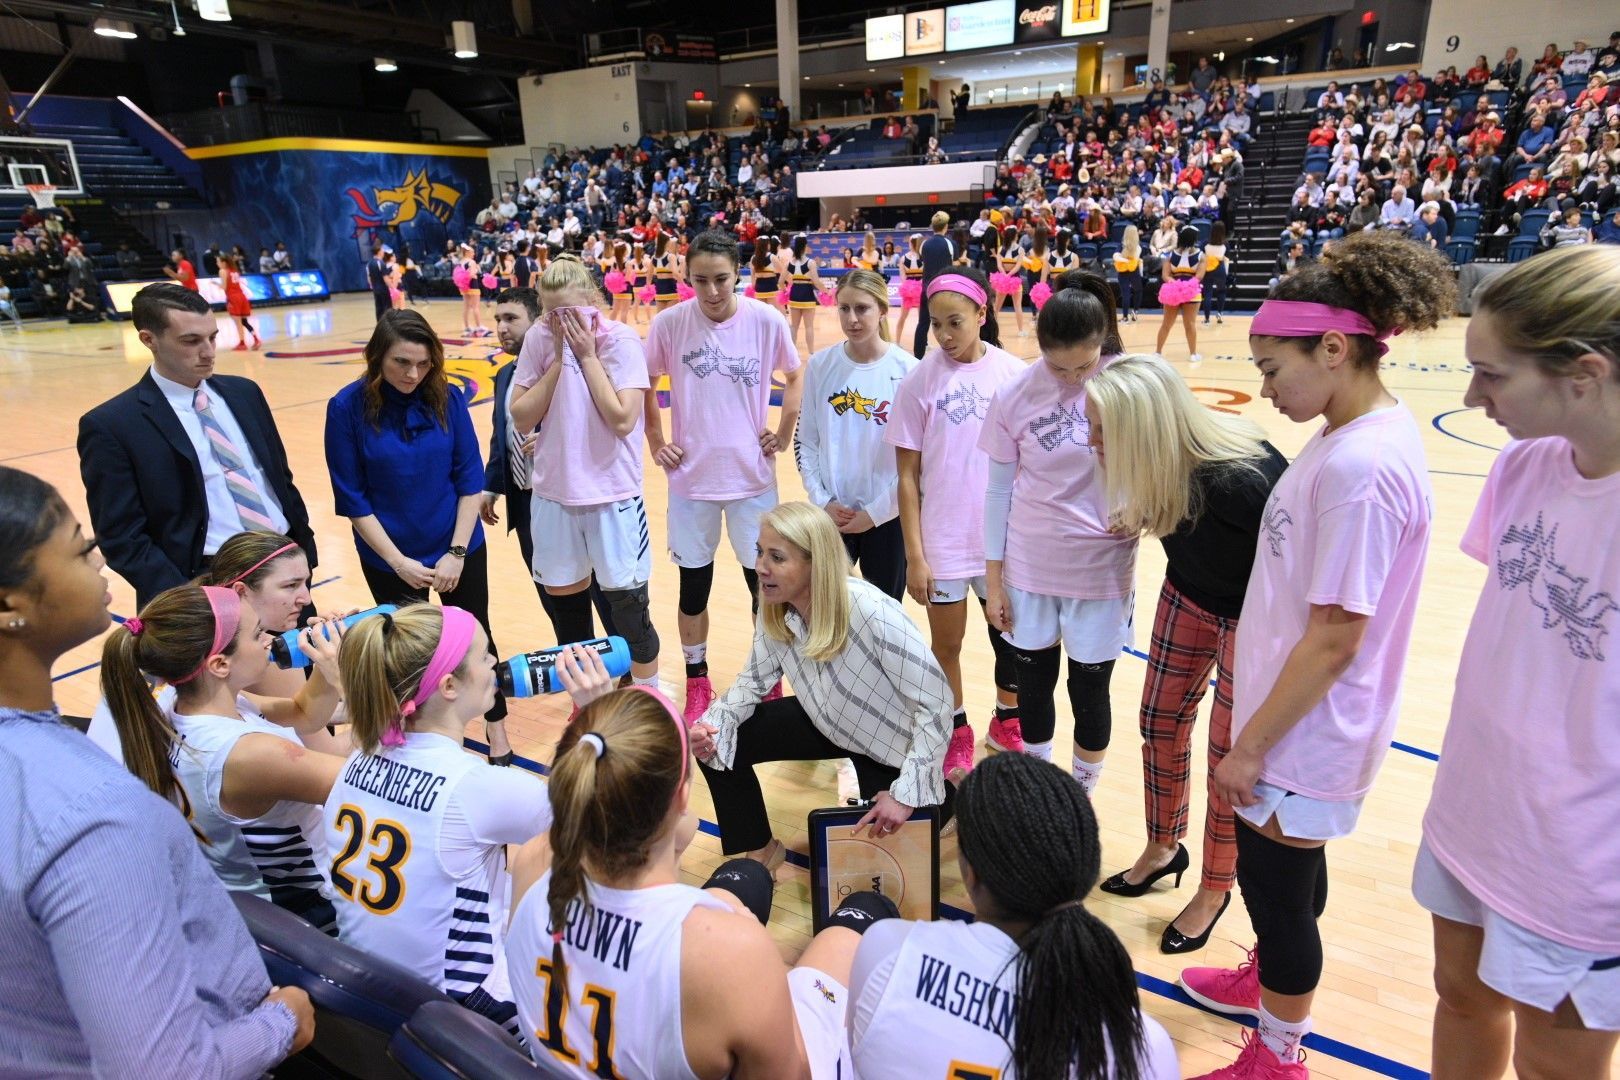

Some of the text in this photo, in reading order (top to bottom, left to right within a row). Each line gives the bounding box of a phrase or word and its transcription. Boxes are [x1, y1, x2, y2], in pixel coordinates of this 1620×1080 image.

[1446, 35, 1460, 53] 9
[611, 64, 631, 77] EAST
[1151, 67, 1160, 84] 8
[623, 122, 630, 133] 6
[344, 751, 447, 813] GREENBERG
[331, 803, 413, 917] 23
[535, 956, 627, 1080] 11
